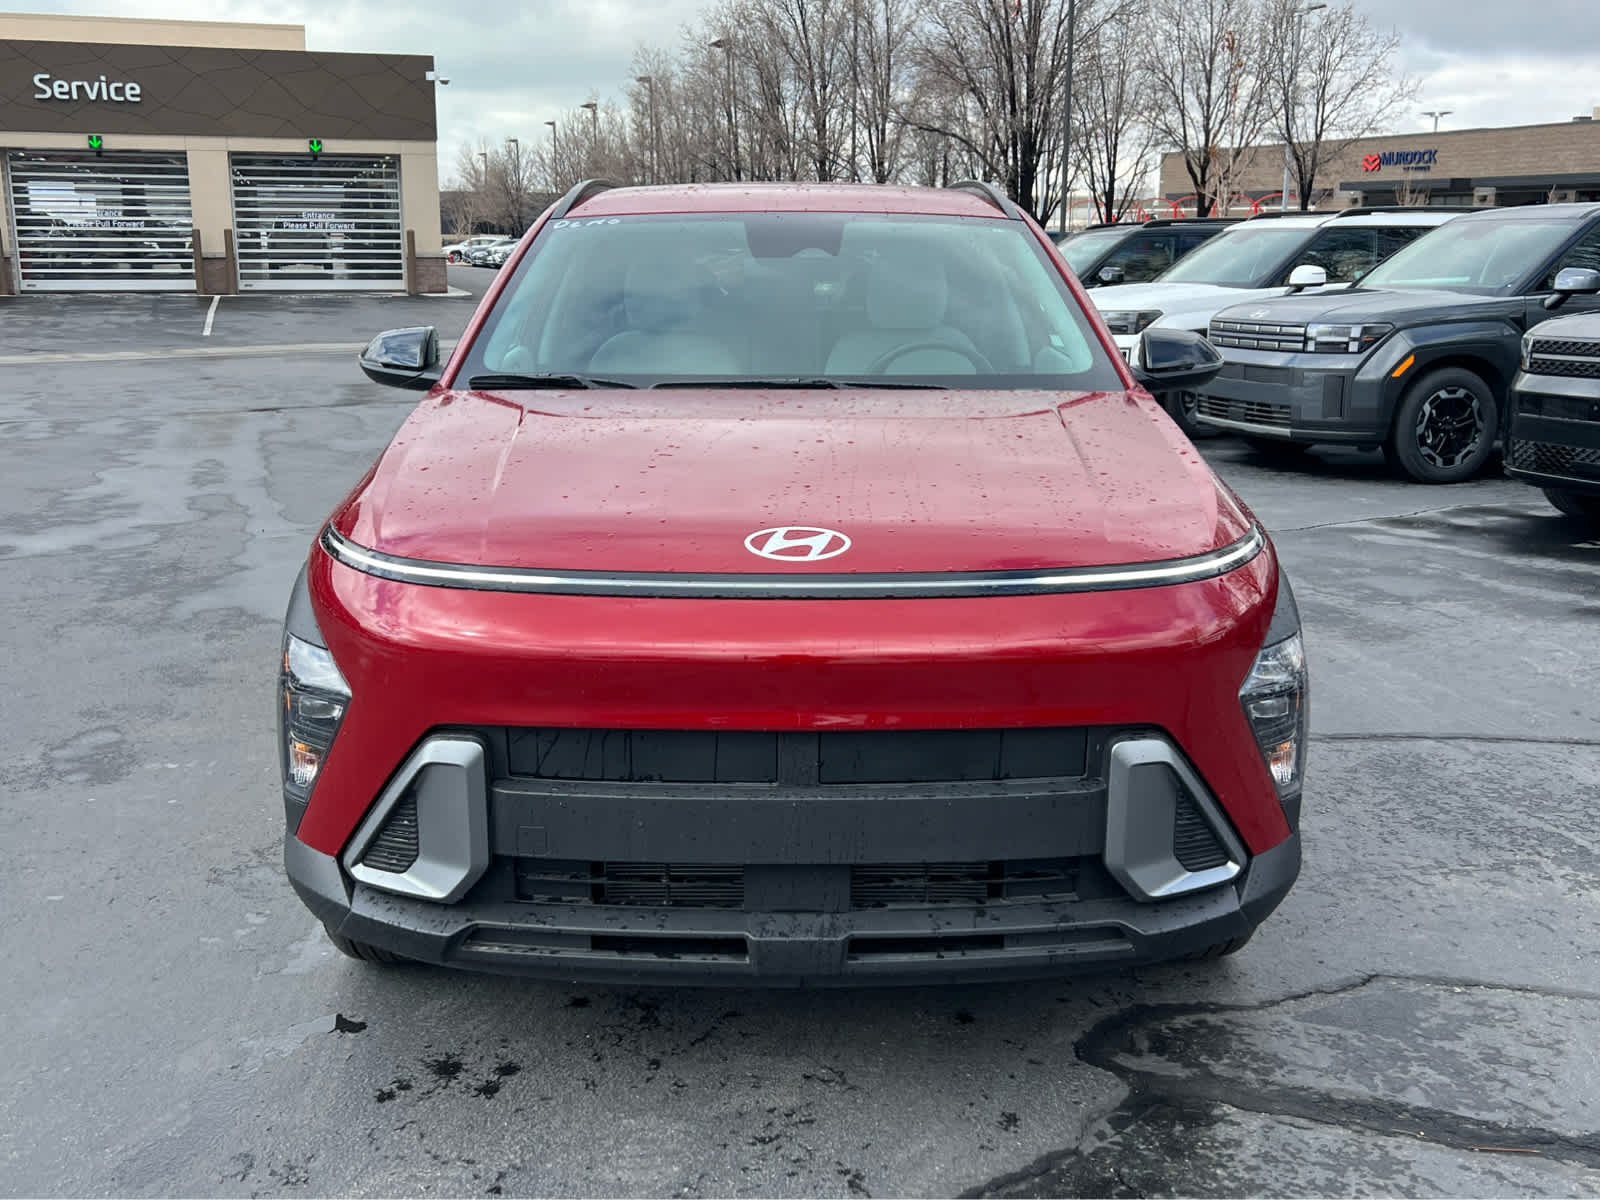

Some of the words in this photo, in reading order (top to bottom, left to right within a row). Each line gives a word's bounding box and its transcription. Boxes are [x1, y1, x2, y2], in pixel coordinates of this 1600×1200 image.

[33, 73, 141, 102] Service
[1381, 150, 1438, 166] MURDOCK
[302, 211, 335, 219] Entrance
[96, 220, 110, 228] Pull
[113, 220, 145, 228] Forward
[283, 221, 308, 229] Please
[309, 221, 323, 229] Pull
[325, 221, 356, 230] Forward
